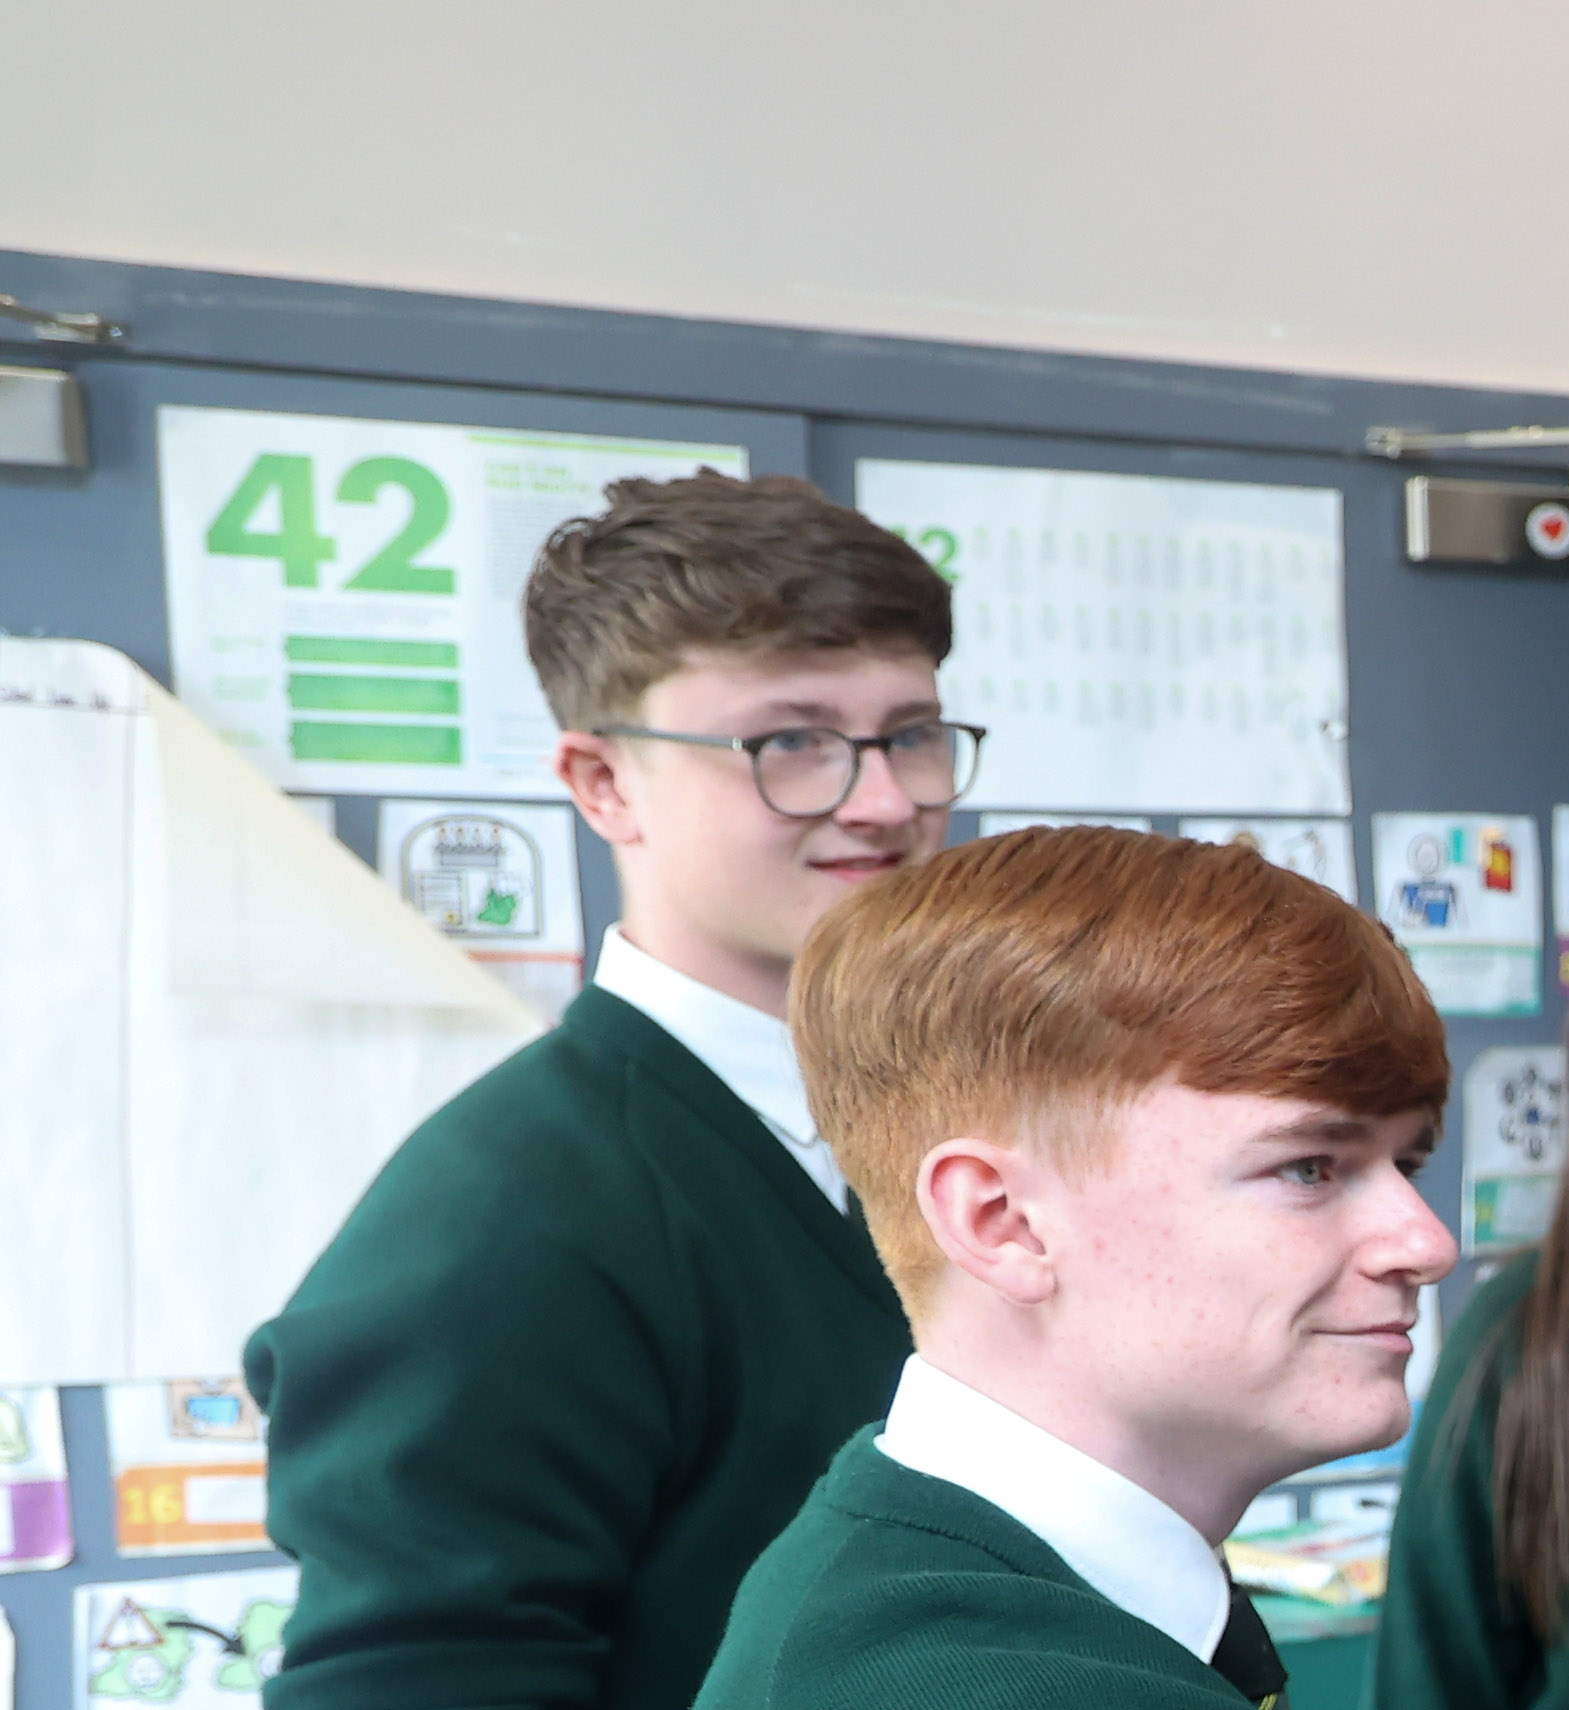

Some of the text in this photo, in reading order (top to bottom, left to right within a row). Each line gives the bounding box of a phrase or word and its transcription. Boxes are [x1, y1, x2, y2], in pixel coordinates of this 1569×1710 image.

[206, 453, 455, 593] 42
[886, 526, 962, 583] 2
[123, 1485, 183, 1524] 16
